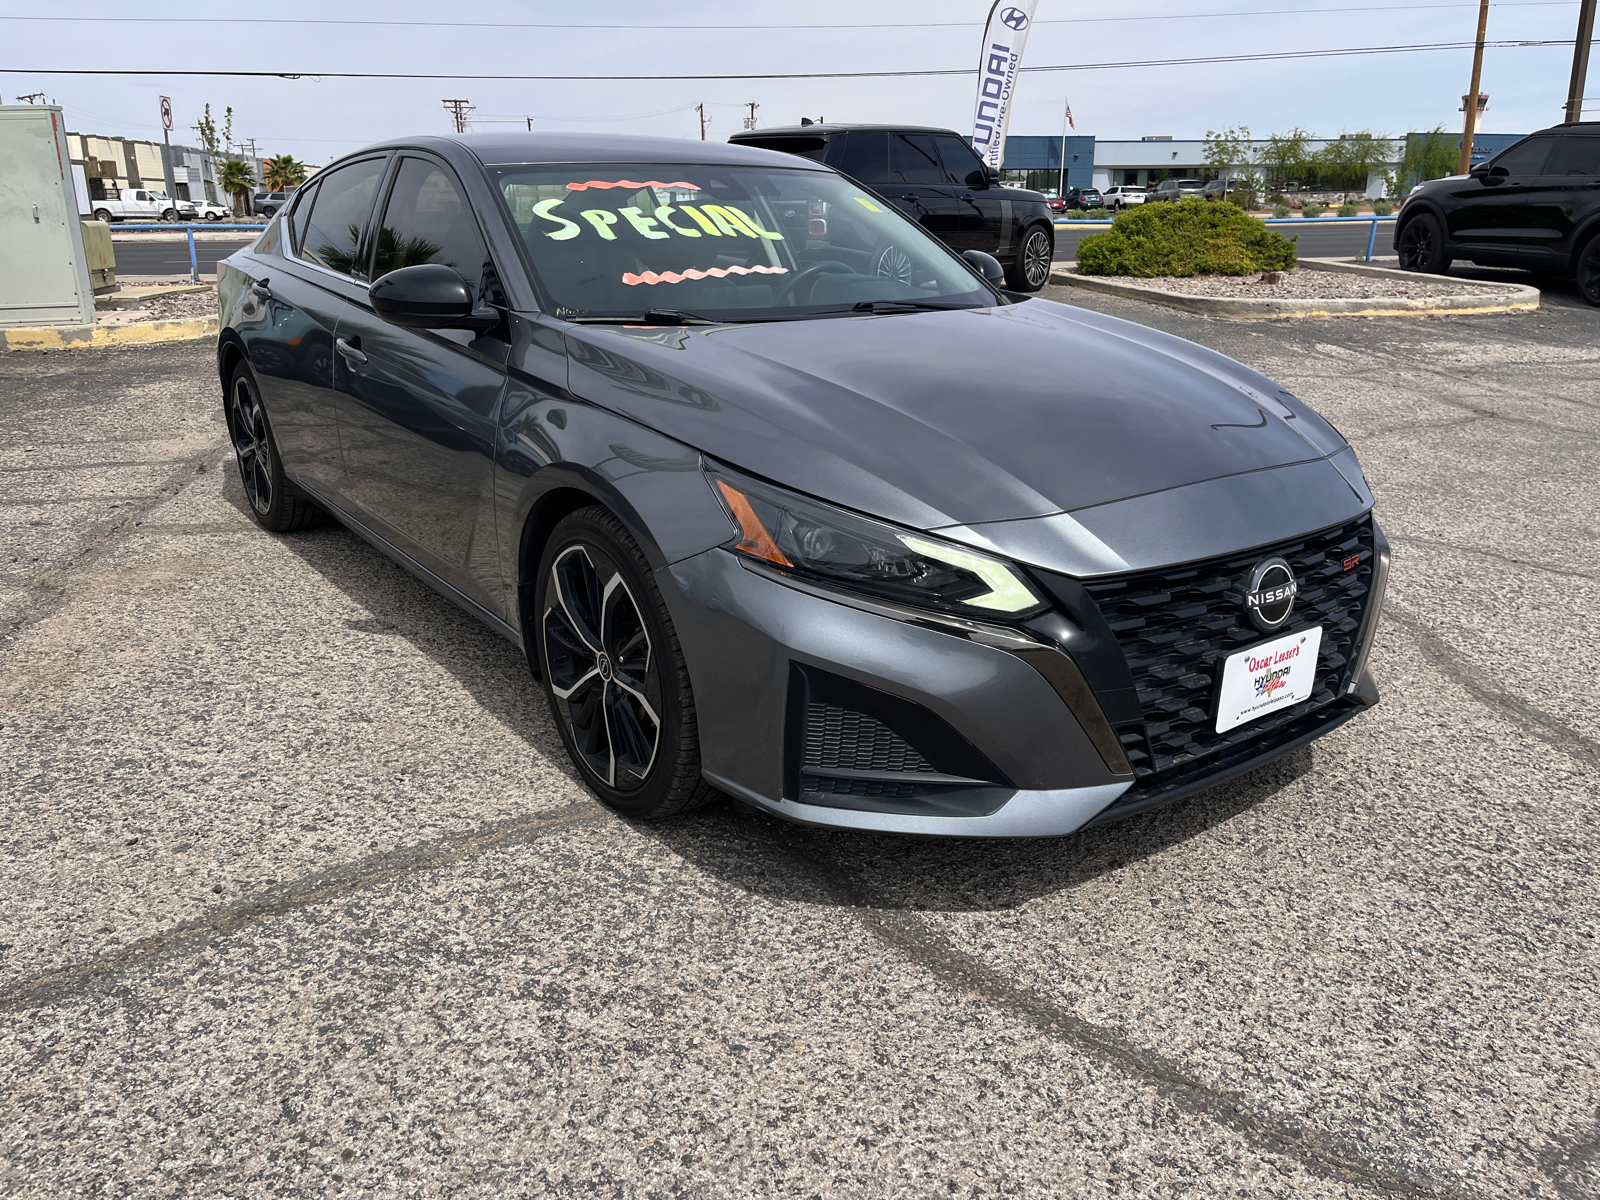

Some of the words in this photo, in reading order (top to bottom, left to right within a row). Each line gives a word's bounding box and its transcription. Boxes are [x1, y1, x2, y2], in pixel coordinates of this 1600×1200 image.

[974, 43, 1010, 159] UNDAI
[989, 130, 1001, 169] rtified
[996, 53, 1018, 128] Pre-Owned
[532, 198, 785, 241] SPECIAL
[1343, 554, 1360, 571] SR
[1248, 582, 1297, 606] NISSAN
[1248, 656, 1273, 673] Oscar
[1254, 665, 1291, 687] HYUNDAI
